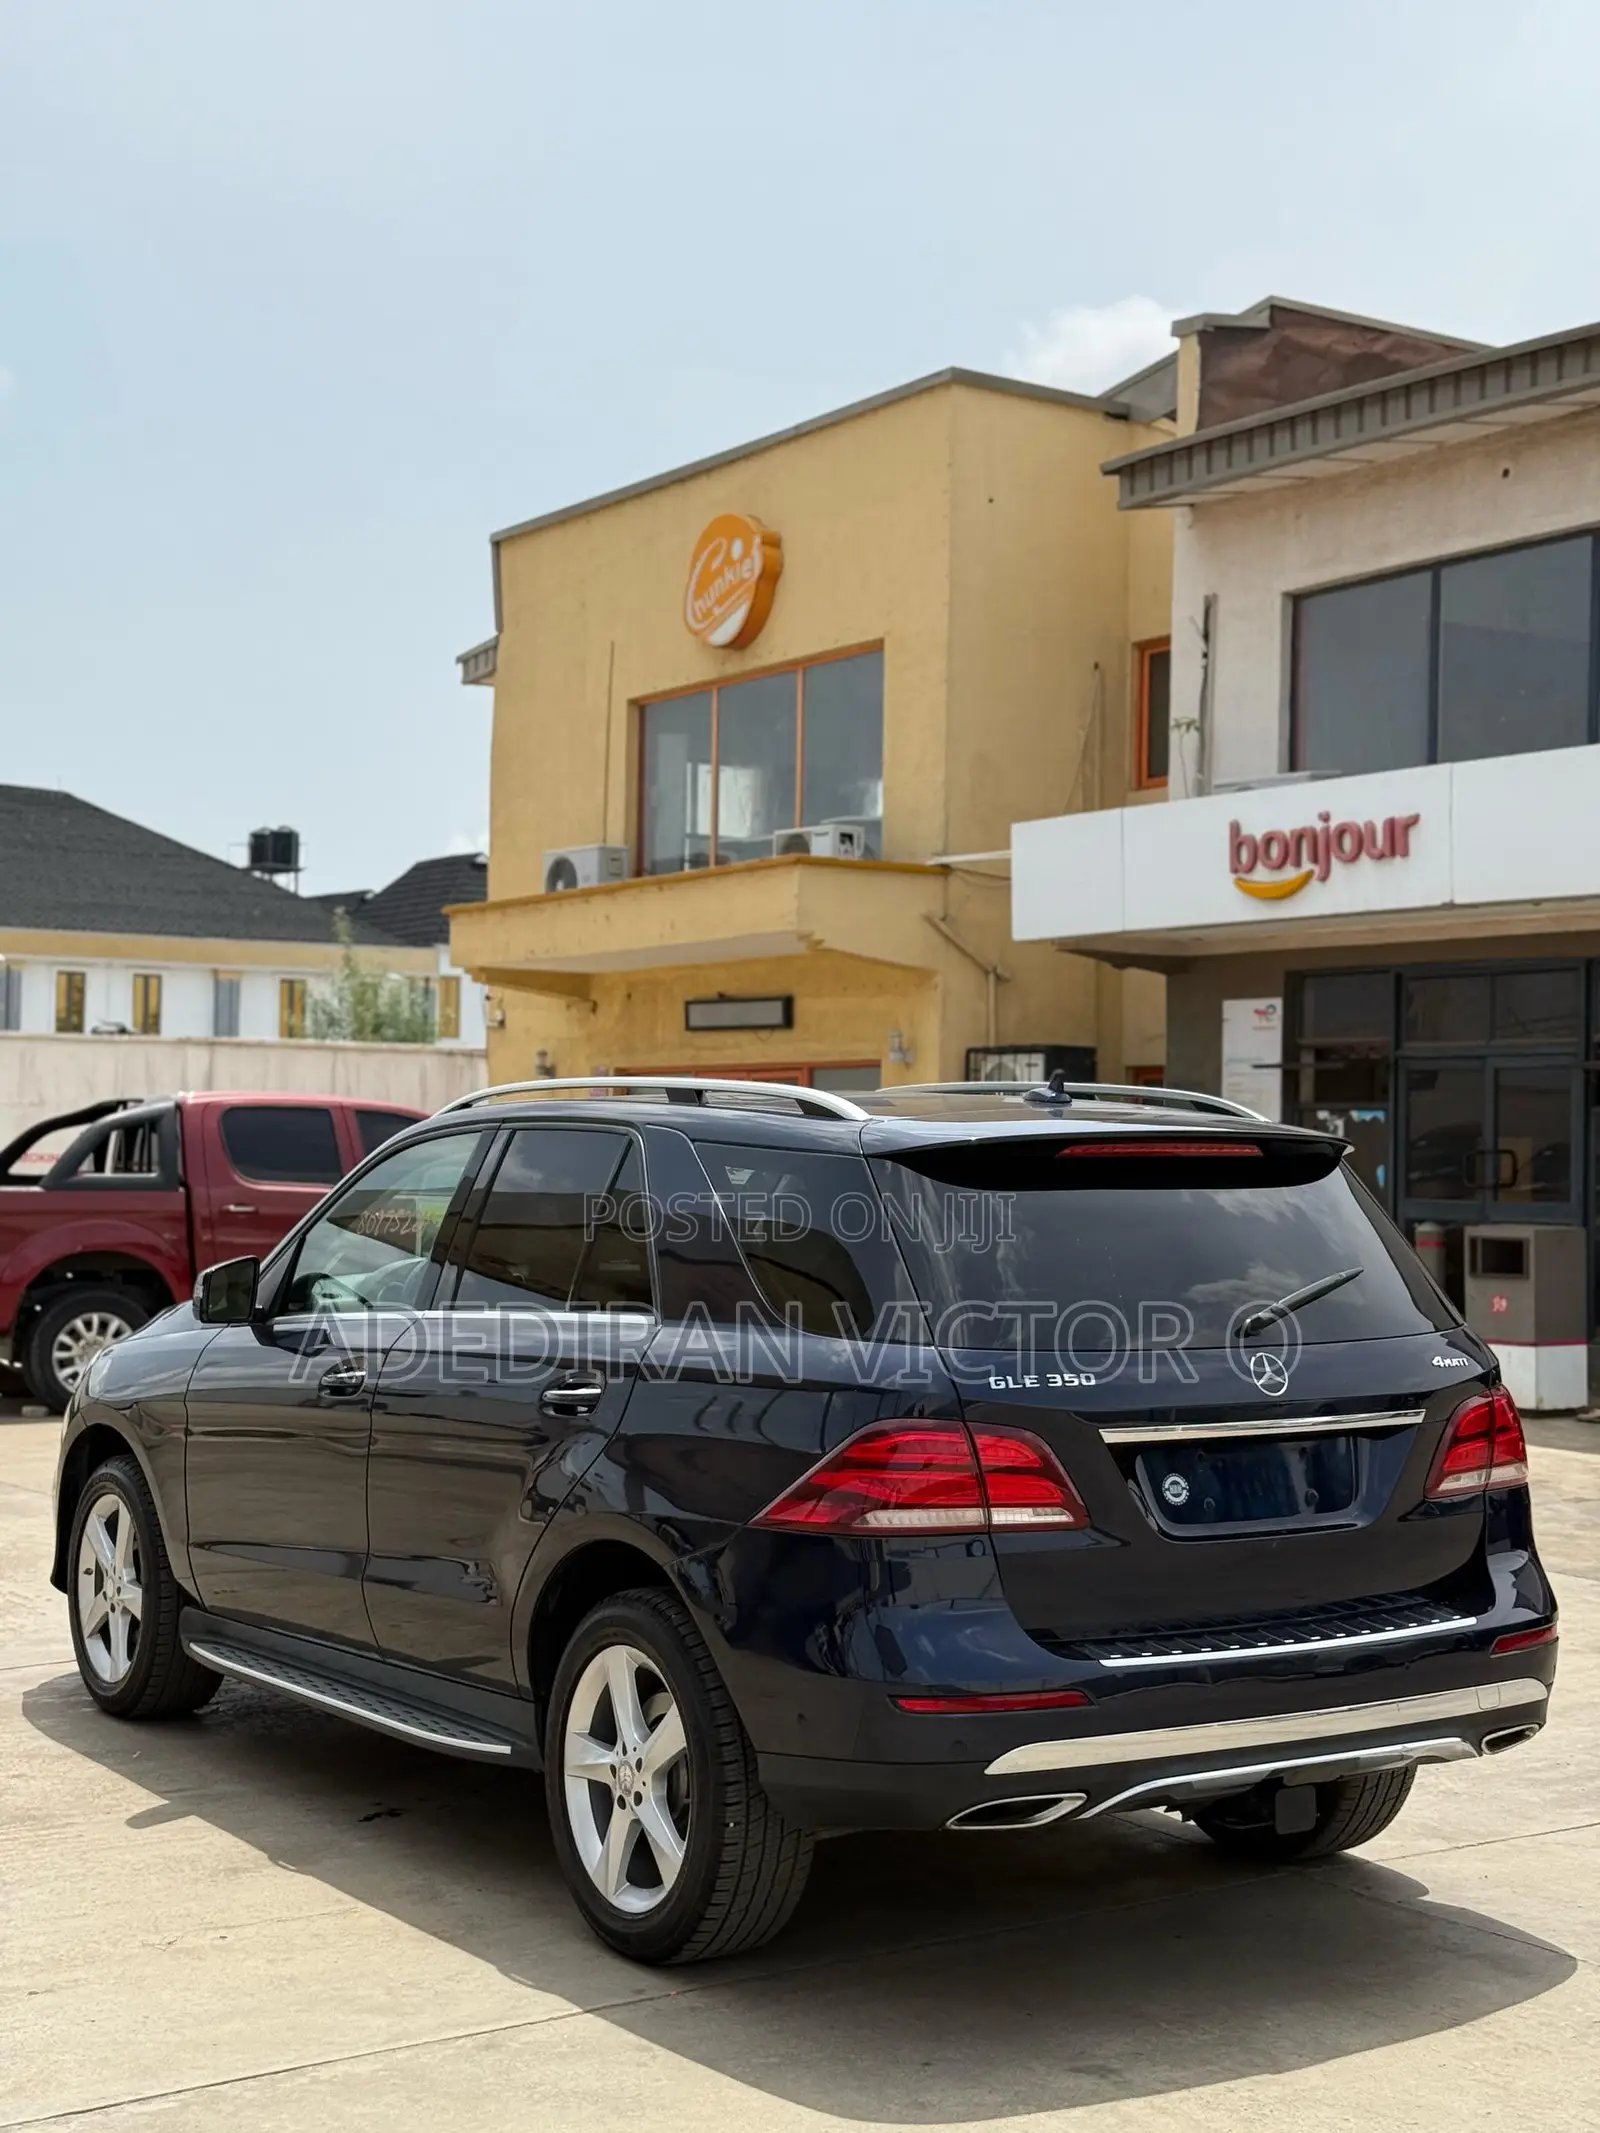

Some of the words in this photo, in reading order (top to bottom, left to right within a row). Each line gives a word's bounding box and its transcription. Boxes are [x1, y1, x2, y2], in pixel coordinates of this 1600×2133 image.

[1229, 811, 1420, 882] bonjour
[988, 1375, 1041, 1390] GLE
[1046, 1373, 1096, 1387] 350
